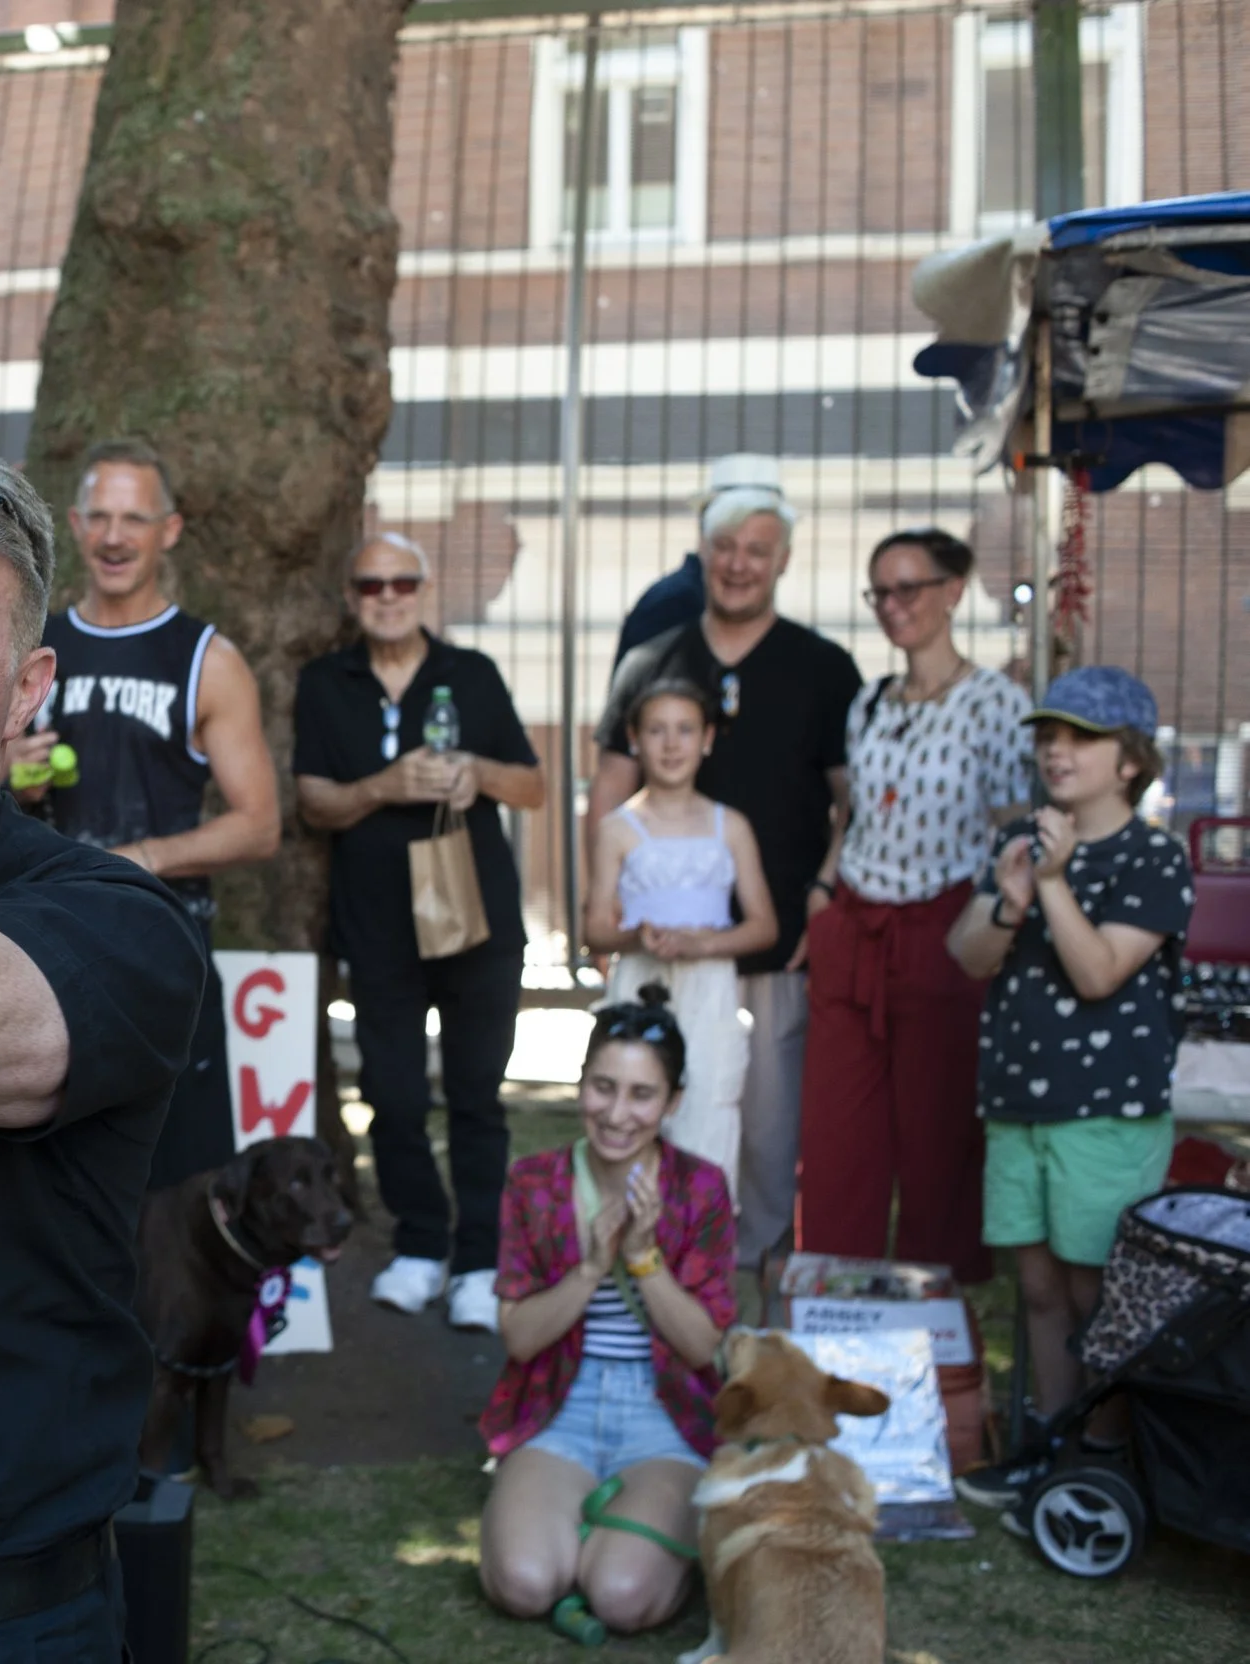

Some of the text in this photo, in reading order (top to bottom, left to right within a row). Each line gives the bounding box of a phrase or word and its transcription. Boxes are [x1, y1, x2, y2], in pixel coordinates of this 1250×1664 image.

[100, 675, 178, 741] YORK
[233, 968, 286, 1039] G
[238, 1064, 315, 1136] W
